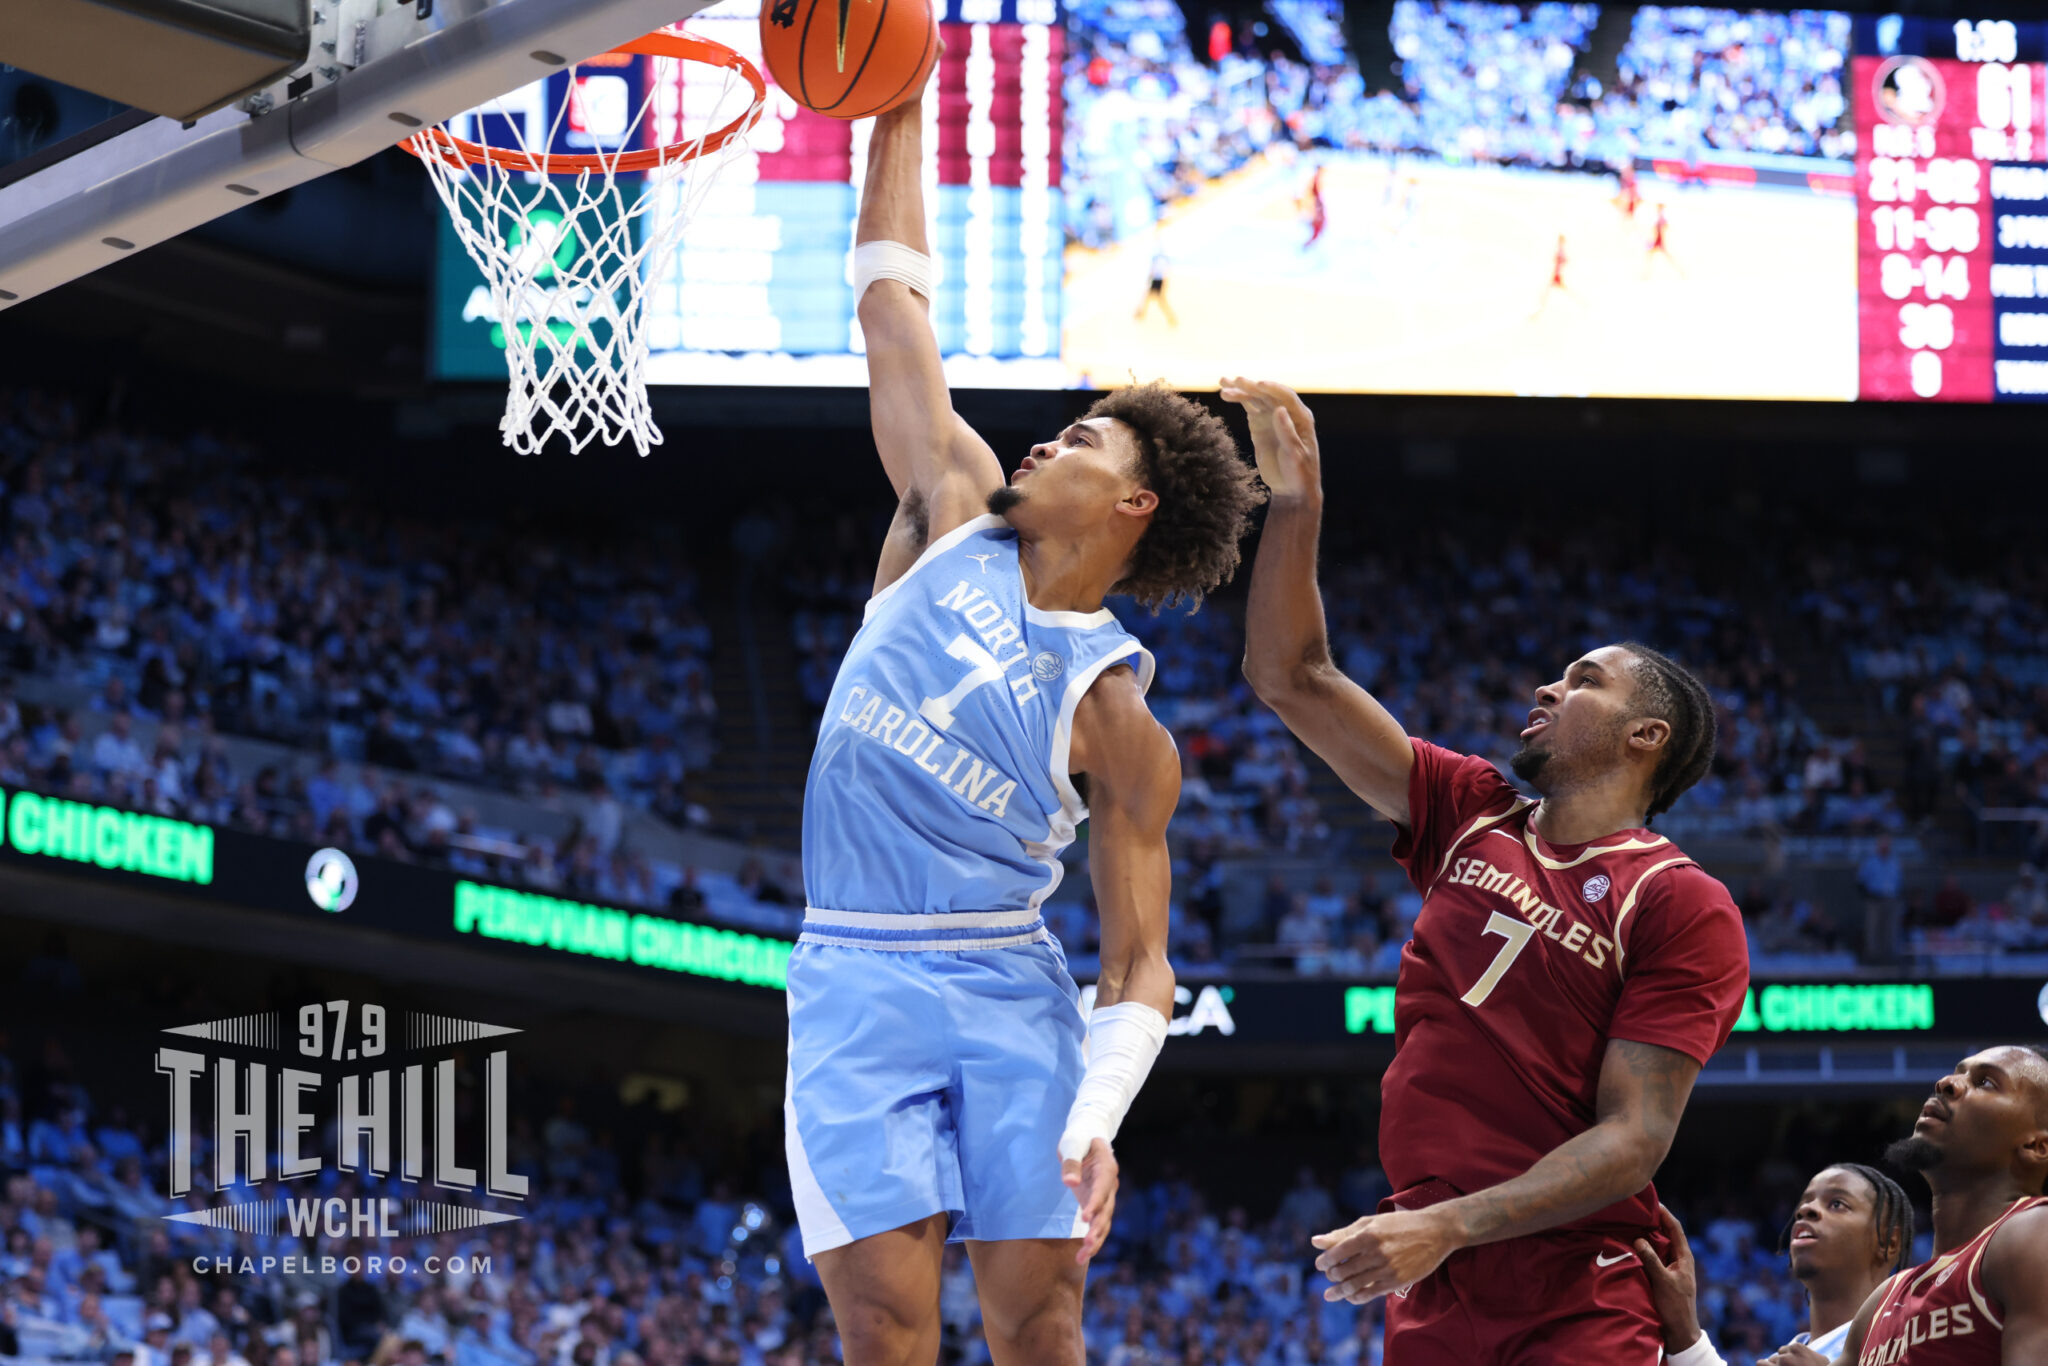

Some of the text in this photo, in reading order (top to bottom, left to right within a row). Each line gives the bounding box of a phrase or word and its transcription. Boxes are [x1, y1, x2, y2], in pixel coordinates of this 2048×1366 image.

[918, 632, 1005, 731] 7
[935, 580, 1039, 707] NORTH
[840, 686, 1018, 818] CAROLINA
[8, 790, 215, 885] CHICKEN
[1448, 857, 1614, 969] SEMINOLES
[1460, 910, 1536, 1008] 7
[1760, 984, 1935, 1032] CHICKEN
